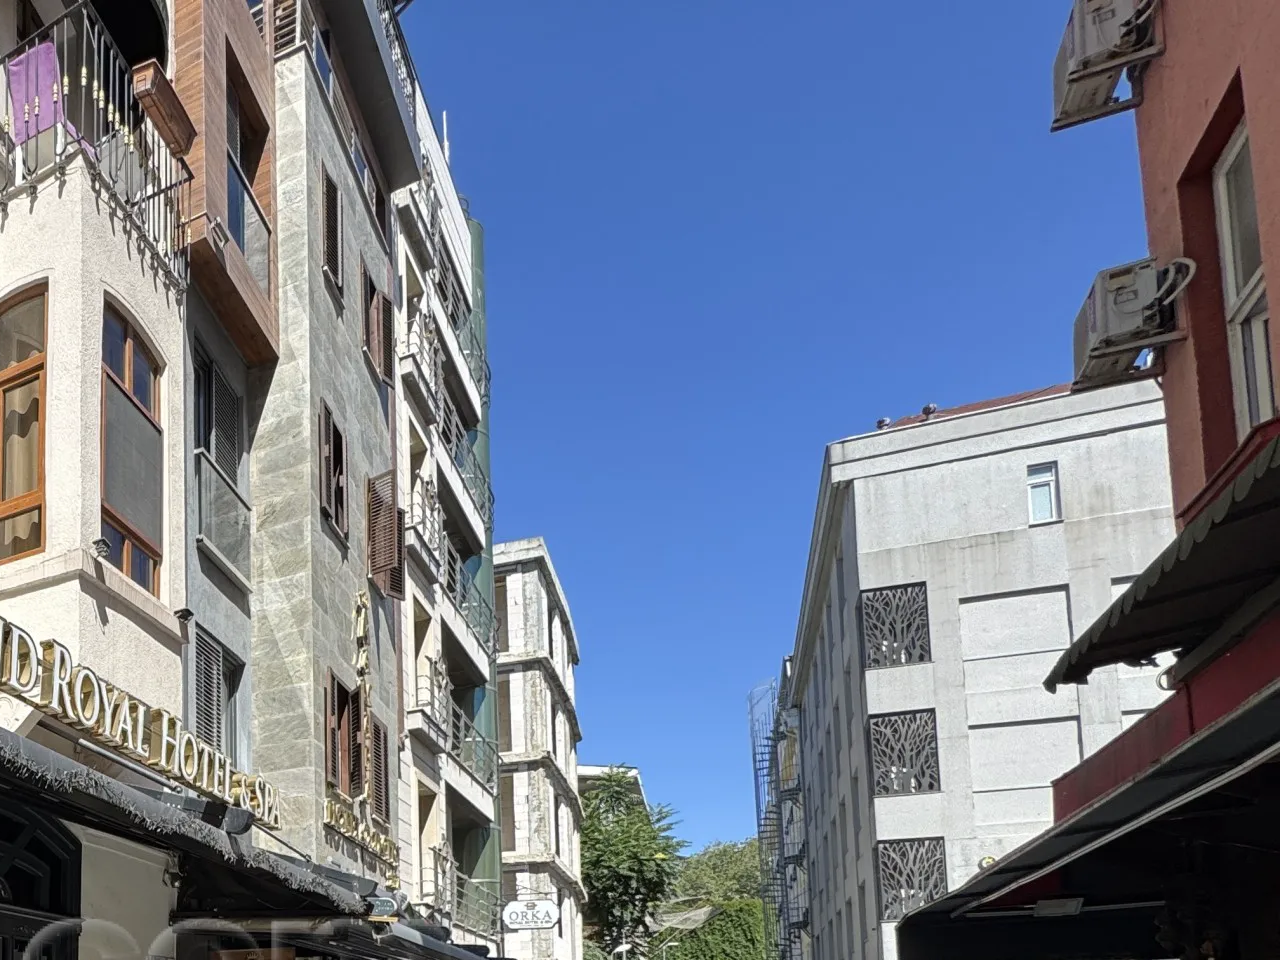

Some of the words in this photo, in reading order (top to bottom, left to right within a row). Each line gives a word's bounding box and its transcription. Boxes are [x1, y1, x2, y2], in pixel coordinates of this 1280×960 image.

[48, 638, 150, 759] ROYAL
[157, 708, 235, 803] HOTEL
[239, 774, 252, 812] &
[255, 773, 282, 830] SPA
[509, 910, 553, 922] ORKA
